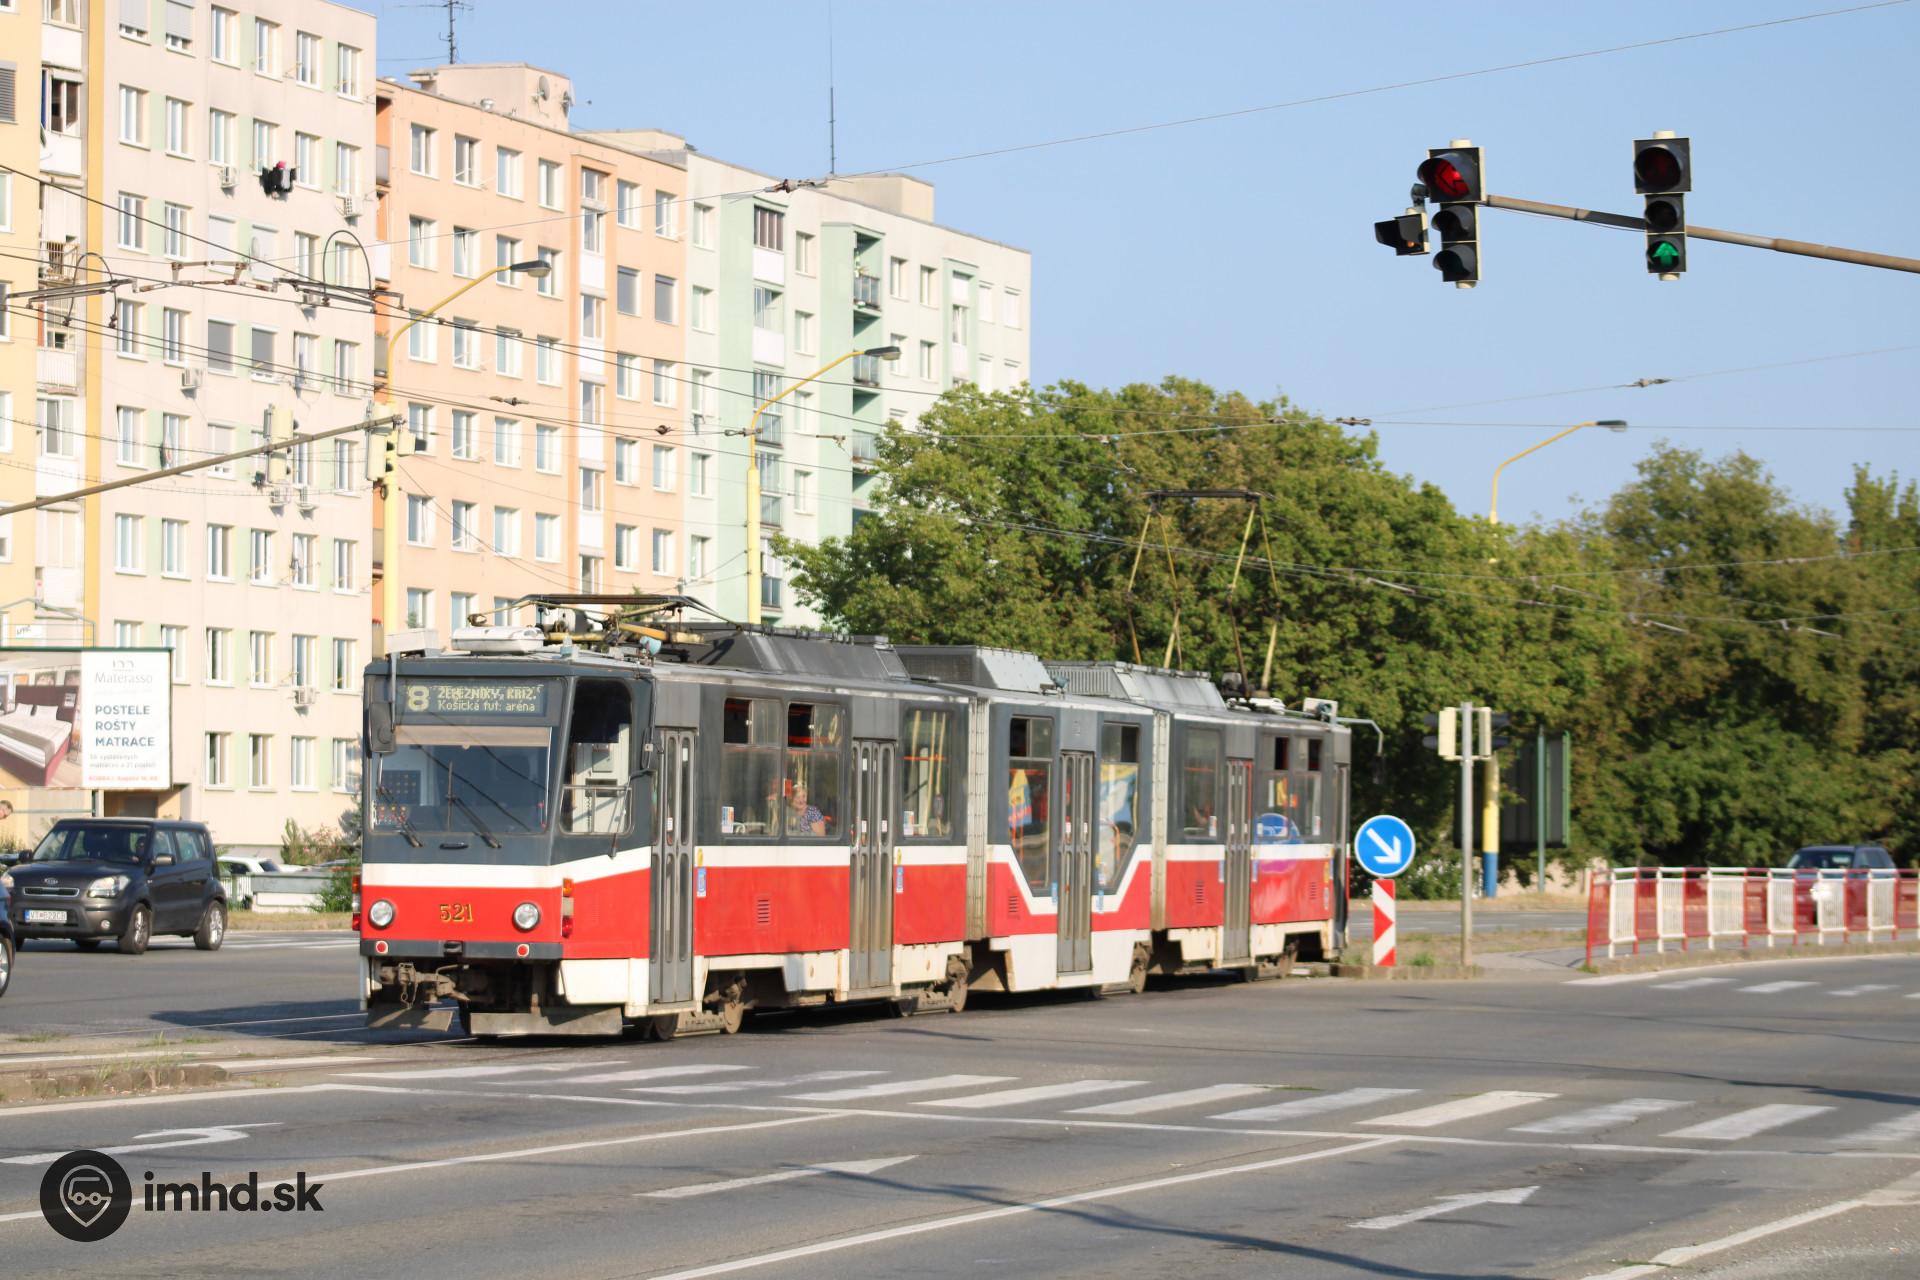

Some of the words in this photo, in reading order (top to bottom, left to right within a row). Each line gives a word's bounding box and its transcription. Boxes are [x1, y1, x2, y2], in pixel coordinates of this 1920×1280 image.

[408, 685, 430, 712] 8
[506, 698, 535, 712] aréna
[95, 704, 151, 715] POSTELE
[95, 719, 136, 731] ROŠTY
[95, 736, 156, 747] MATRACE
[439, 903, 473, 922] 521
